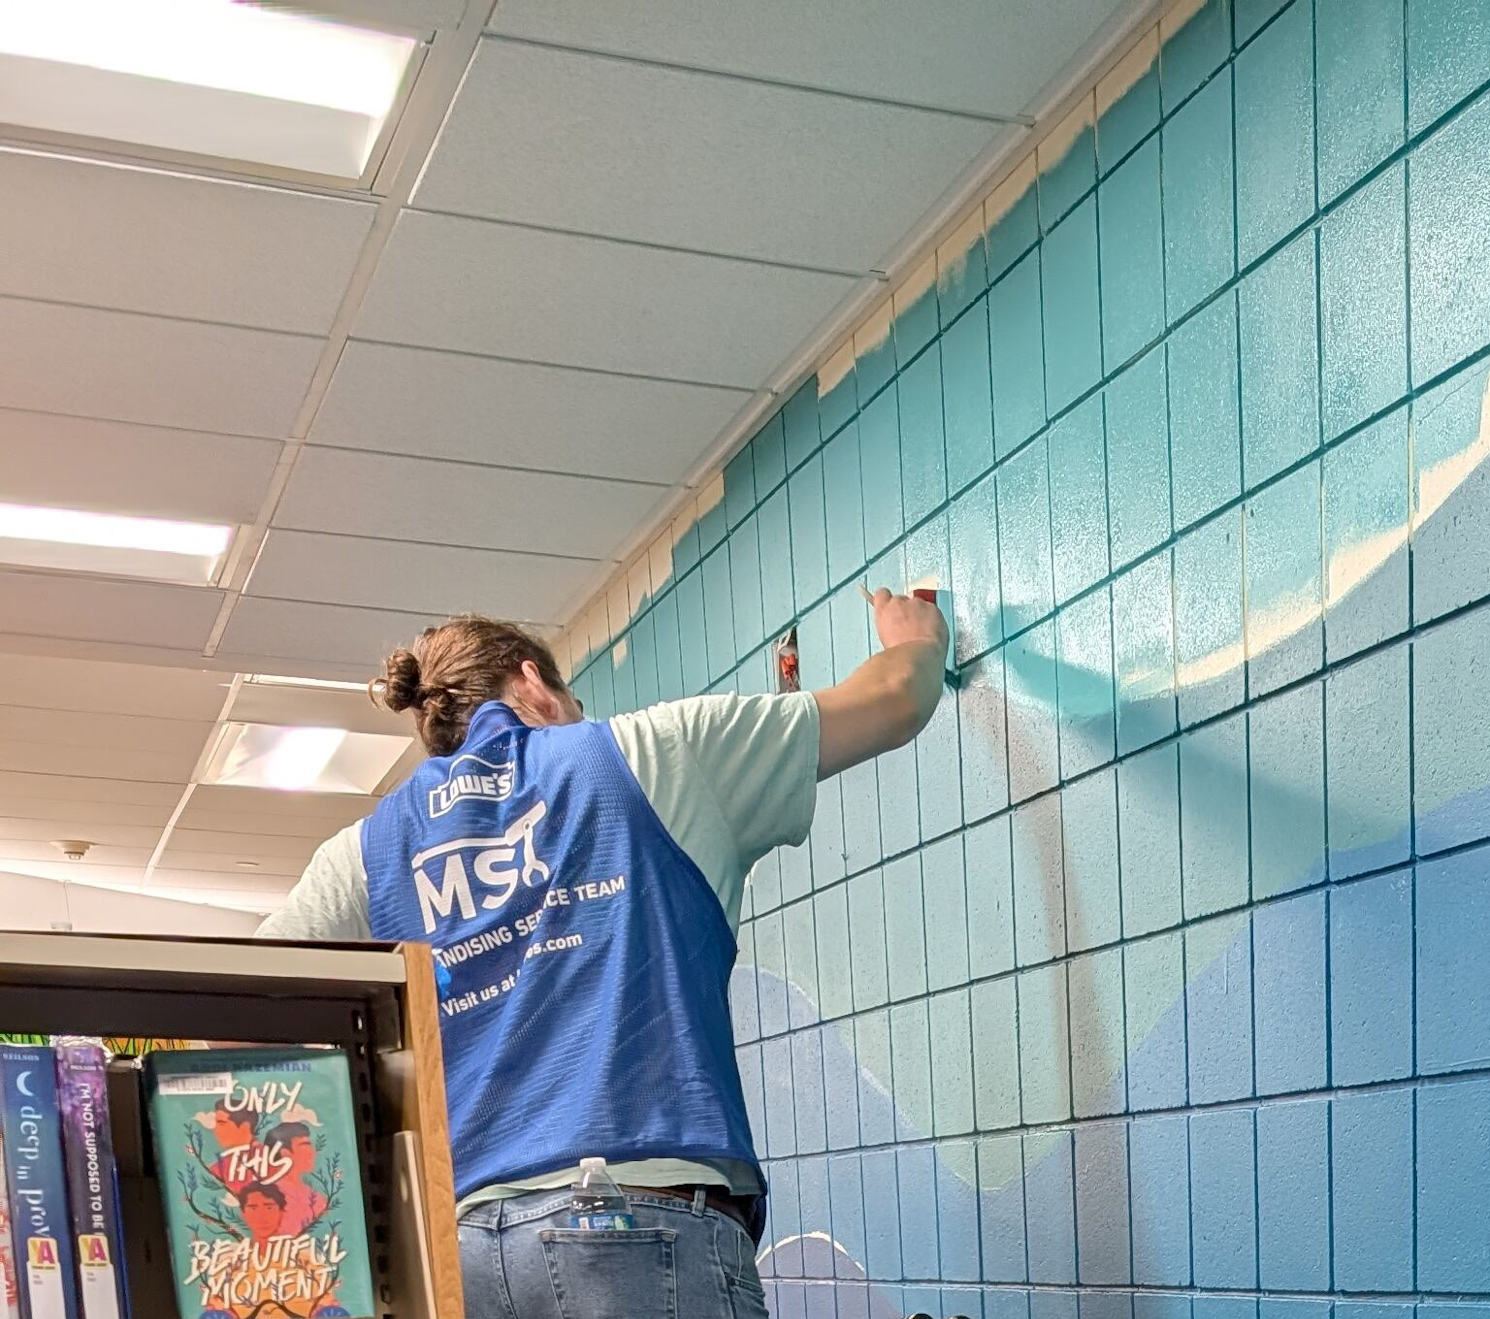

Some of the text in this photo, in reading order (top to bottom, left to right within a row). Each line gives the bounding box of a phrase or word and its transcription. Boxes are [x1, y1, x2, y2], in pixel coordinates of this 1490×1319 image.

[440, 772, 512, 810] LOWE'S
[574, 876, 625, 902] TEAM
[441, 990, 479, 1017] Visit
[479, 981, 500, 1001] us
[501, 974, 516, 993] at
[82, 1103, 95, 1129] NOT
[224, 1081, 302, 1114] ONLY
[18, 1106, 42, 1161] deep
[86, 1132, 103, 1192] SUPPOSED
[221, 1142, 292, 1185] THIS
[90, 1195, 103, 1213] TO
[92, 1215, 105, 1229] BE
[184, 1234, 348, 1285] BEAUTIFUL
[201, 1266, 337, 1308] MOMENT
